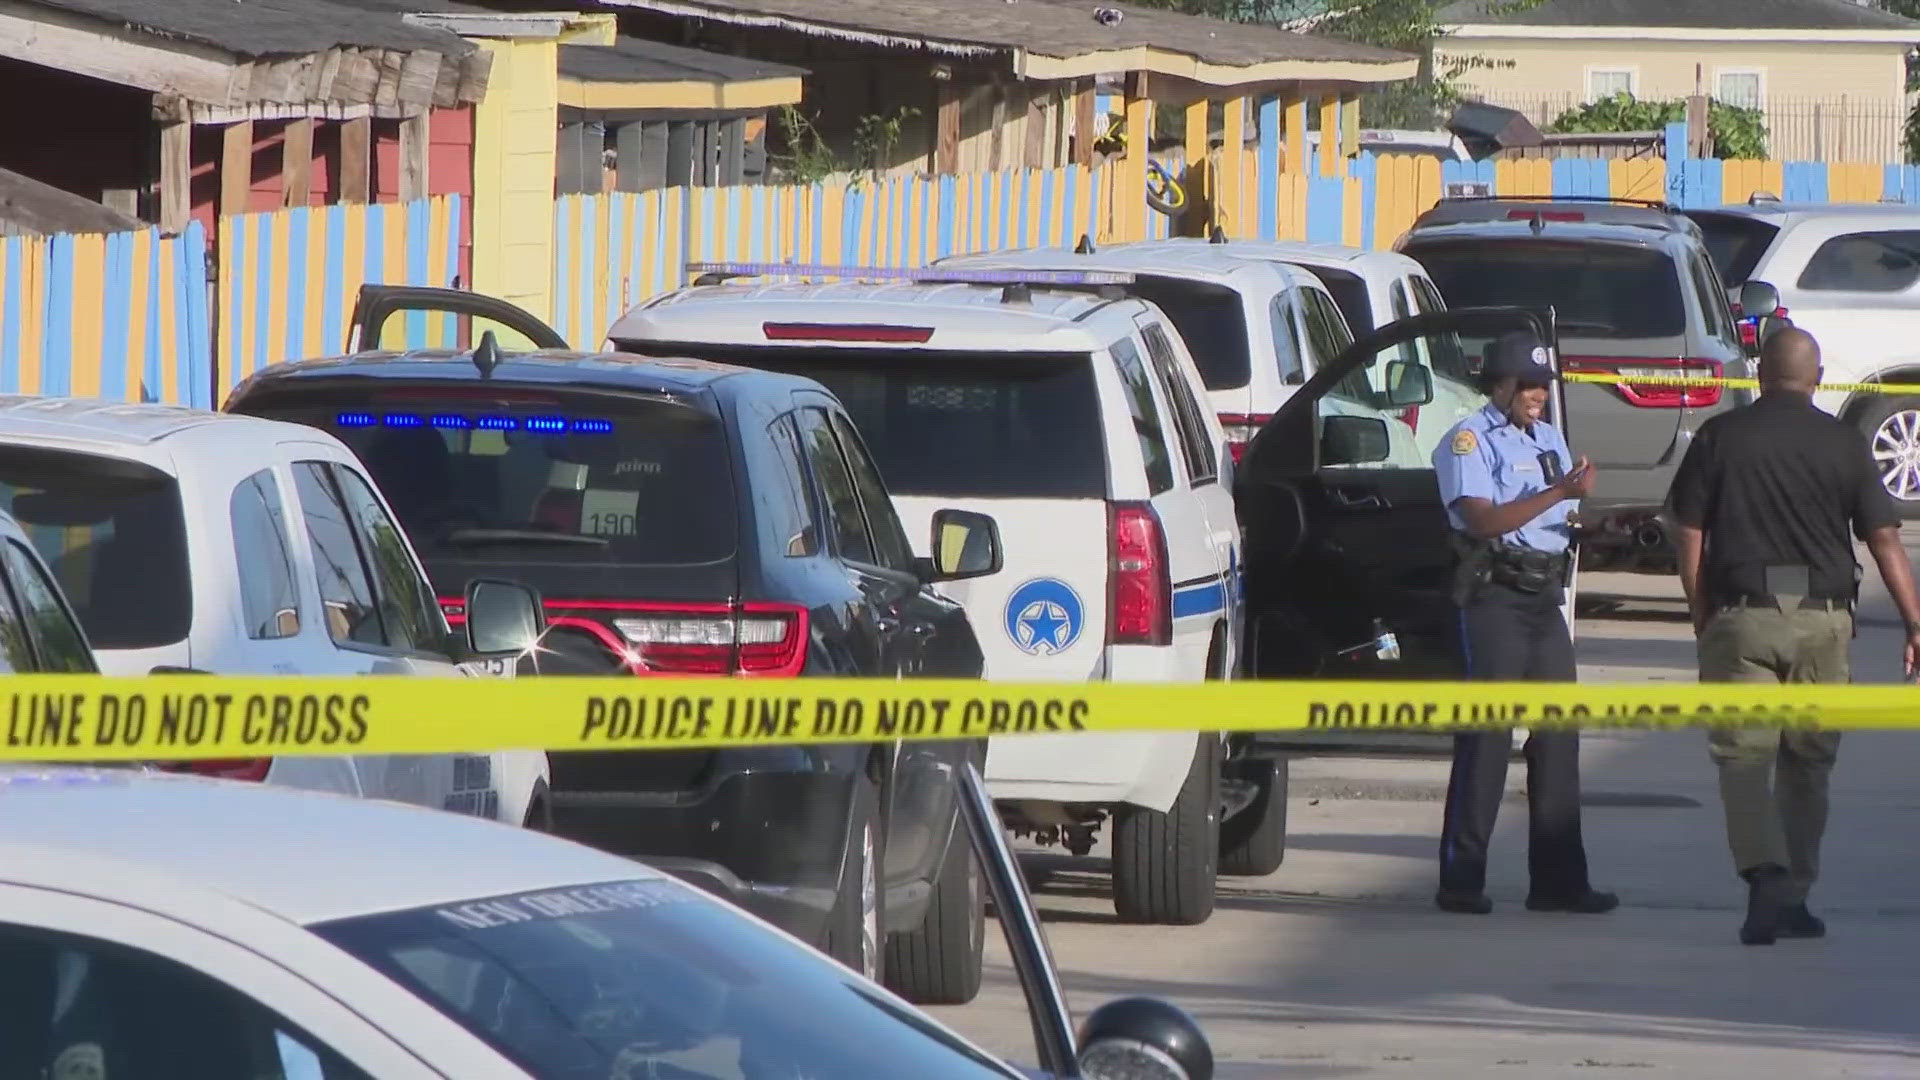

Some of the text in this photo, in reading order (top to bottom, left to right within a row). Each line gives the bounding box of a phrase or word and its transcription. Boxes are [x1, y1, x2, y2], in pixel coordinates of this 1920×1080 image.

[6, 693, 371, 747] LINE DO NOT CROSS
[579, 696, 1090, 743] POLICE LINE DO NOT CROSS
[437, 901, 533, 929] NEW
